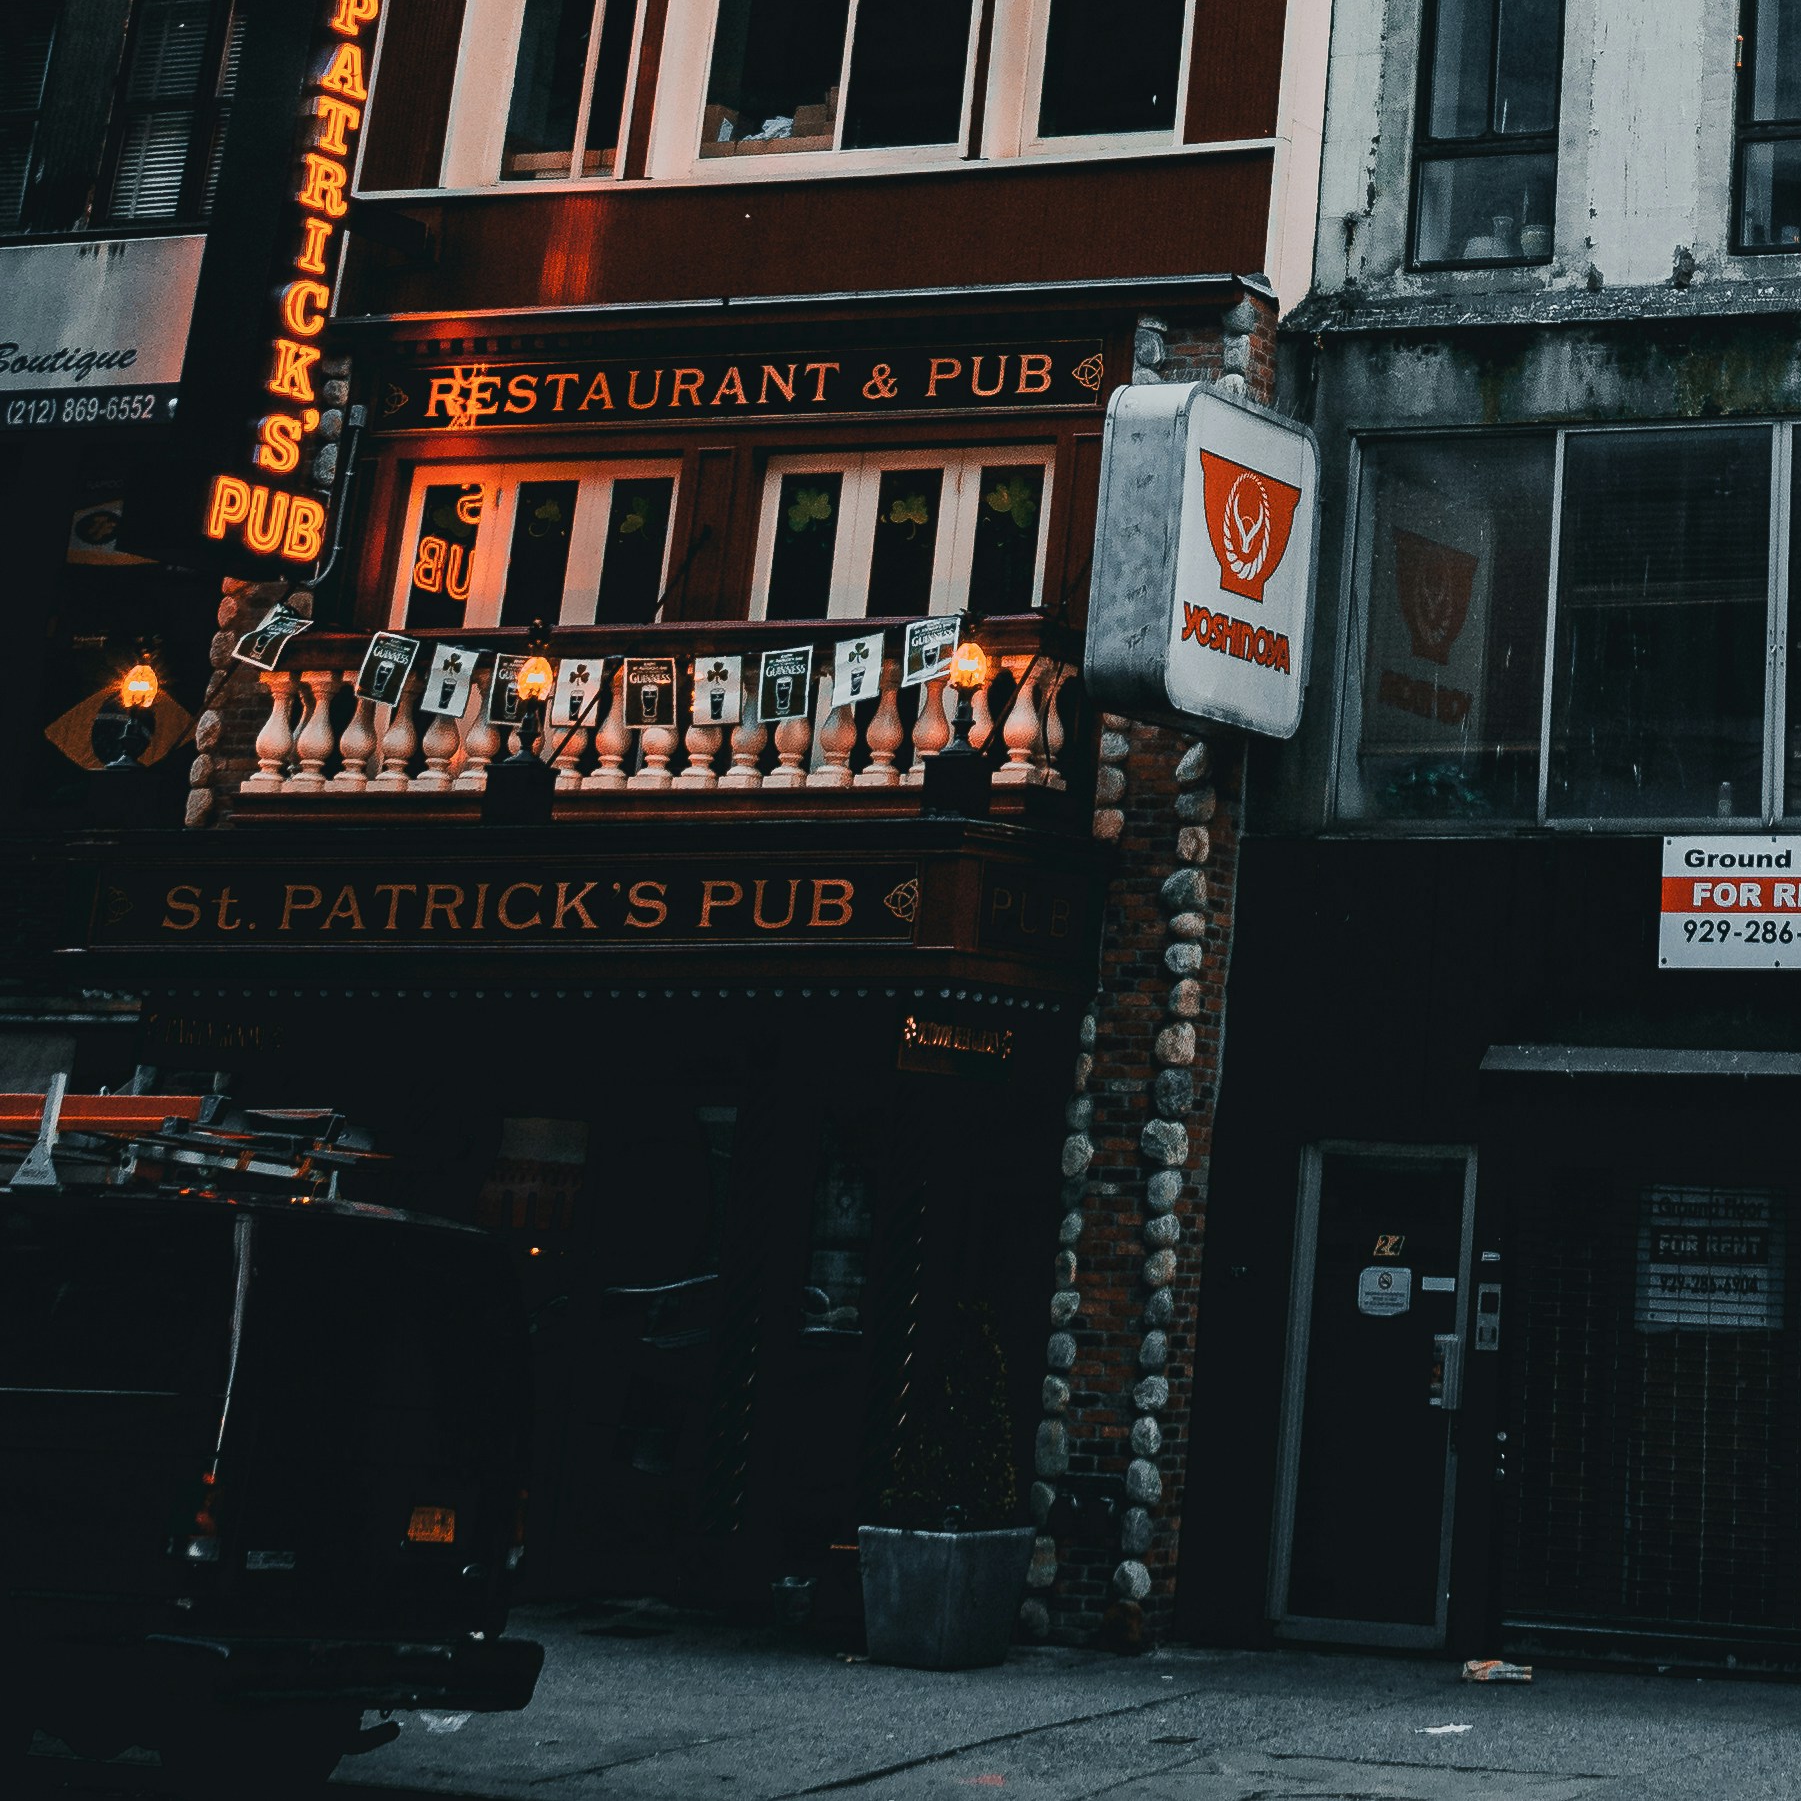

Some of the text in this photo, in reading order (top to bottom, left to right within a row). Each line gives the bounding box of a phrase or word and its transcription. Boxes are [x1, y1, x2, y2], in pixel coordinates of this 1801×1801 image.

[0, 341, 138, 383] Boutique
[424, 354, 1054, 419] RESTAURANT & PUB
[7, 394, 156, 425] (212) 869-6552
[207, 474, 326, 562] PUB
[1181, 601, 1291, 676] YOSHINOYA
[765, 663, 807, 678] GUINNESS
[1684, 849, 1792, 869] Ground
[161, 878, 857, 932] St. PATRICK'S PUB
[992, 886, 1072, 940] PUB
[1692, 882, 1763, 908] FOR
[1658, 1232, 1762, 1258] FOR RENT
